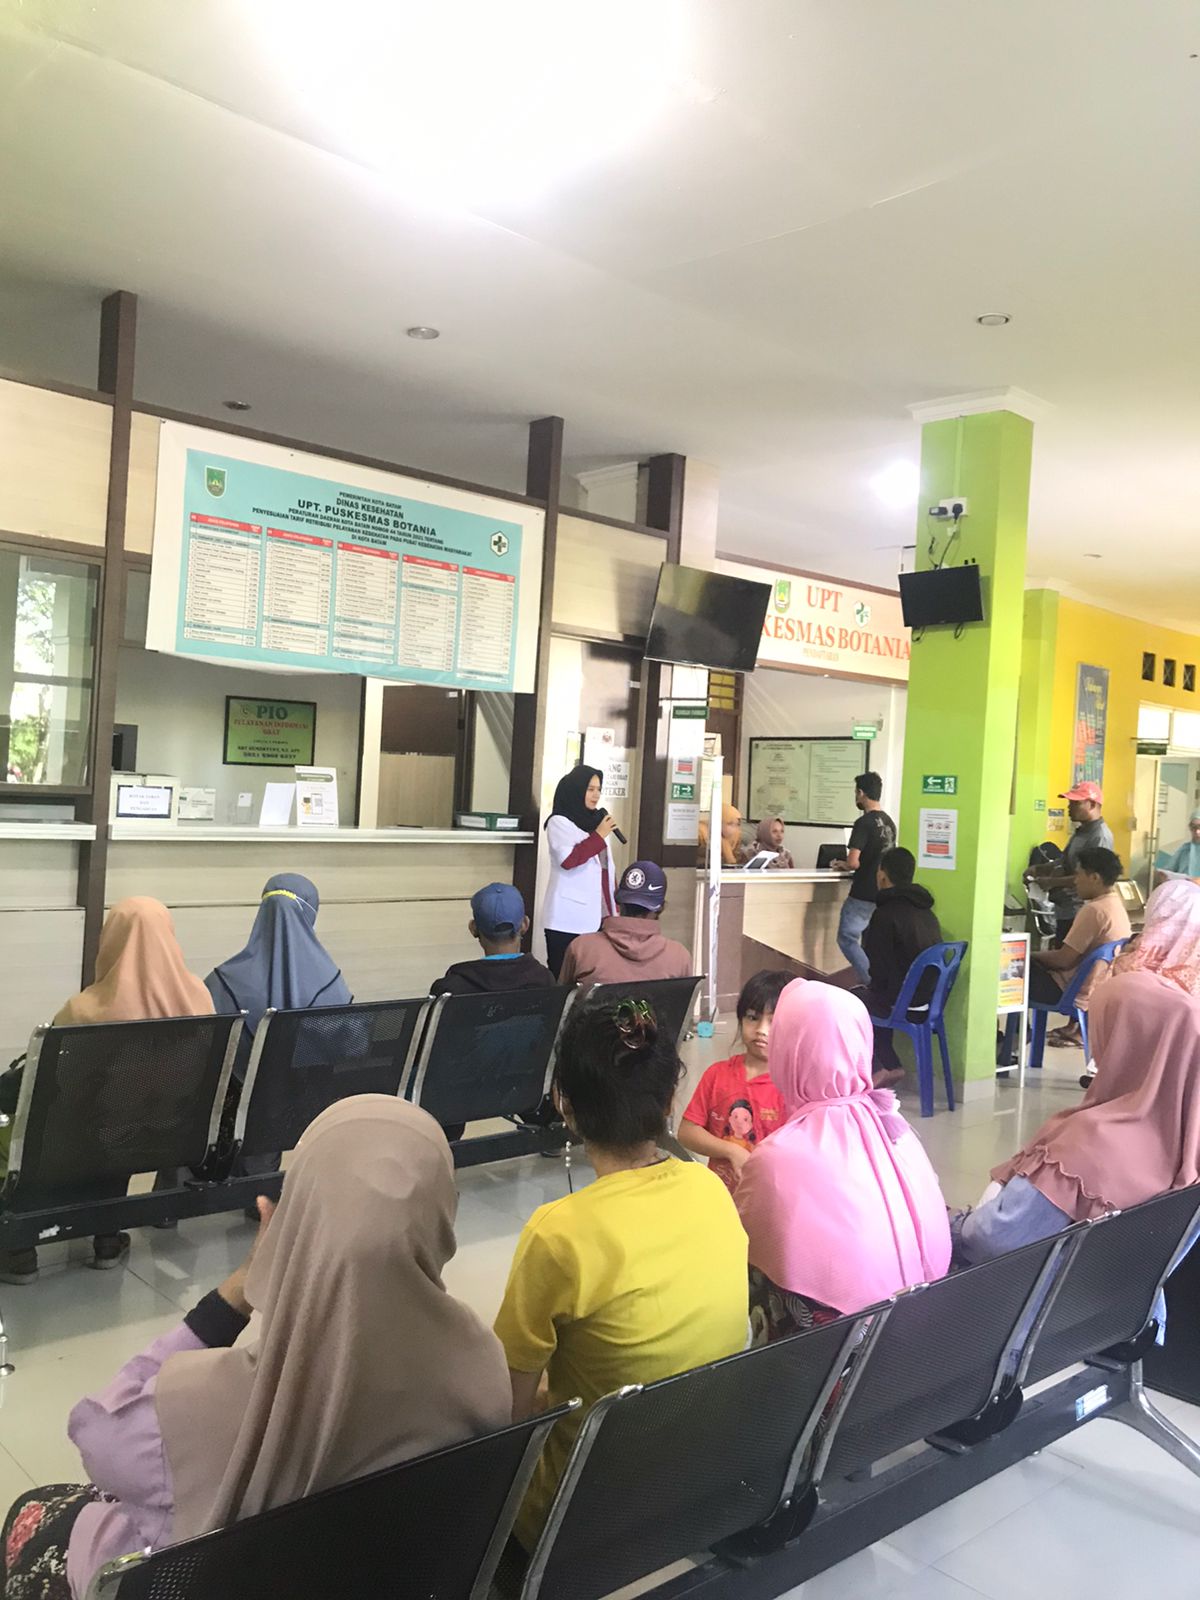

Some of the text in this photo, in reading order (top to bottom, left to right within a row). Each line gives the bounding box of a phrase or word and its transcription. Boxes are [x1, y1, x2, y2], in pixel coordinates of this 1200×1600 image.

[336, 497, 404, 519] DINAS KESEHATAN
[371, 497, 385, 506] KOTA
[288, 507, 319, 519] PERATURAN
[320, 513, 340, 523] DAERAH
[341, 518, 354, 526] KOTA
[355, 522, 371, 530] BATAM
[372, 525, 389, 533] NOMOR
[397, 530, 412, 538] TAHUN
[298, 499, 437, 536] UPT. PUSKESMAS BOTANIA
[252, 507, 289, 519] PENYESUAIAN
[290, 514, 305, 522] TARIF
[305, 518, 332, 528] RETRIBUSI
[333, 524, 361, 534] PELAYANAN
[362, 529, 389, 540] KESEHATAN
[390, 535, 402, 543] PADA
[418, 541, 443, 552] KESEHATAN
[444, 545, 473, 557] MASYARAKAT
[371, 538, 387, 546] BATAM
[807, 585, 843, 612] UPT
[762, 615, 912, 661] KESMAS BOTANIA
[234, 719, 309, 729] PELAYANAN INFORMASI
[256, 705, 288, 720] PIO
